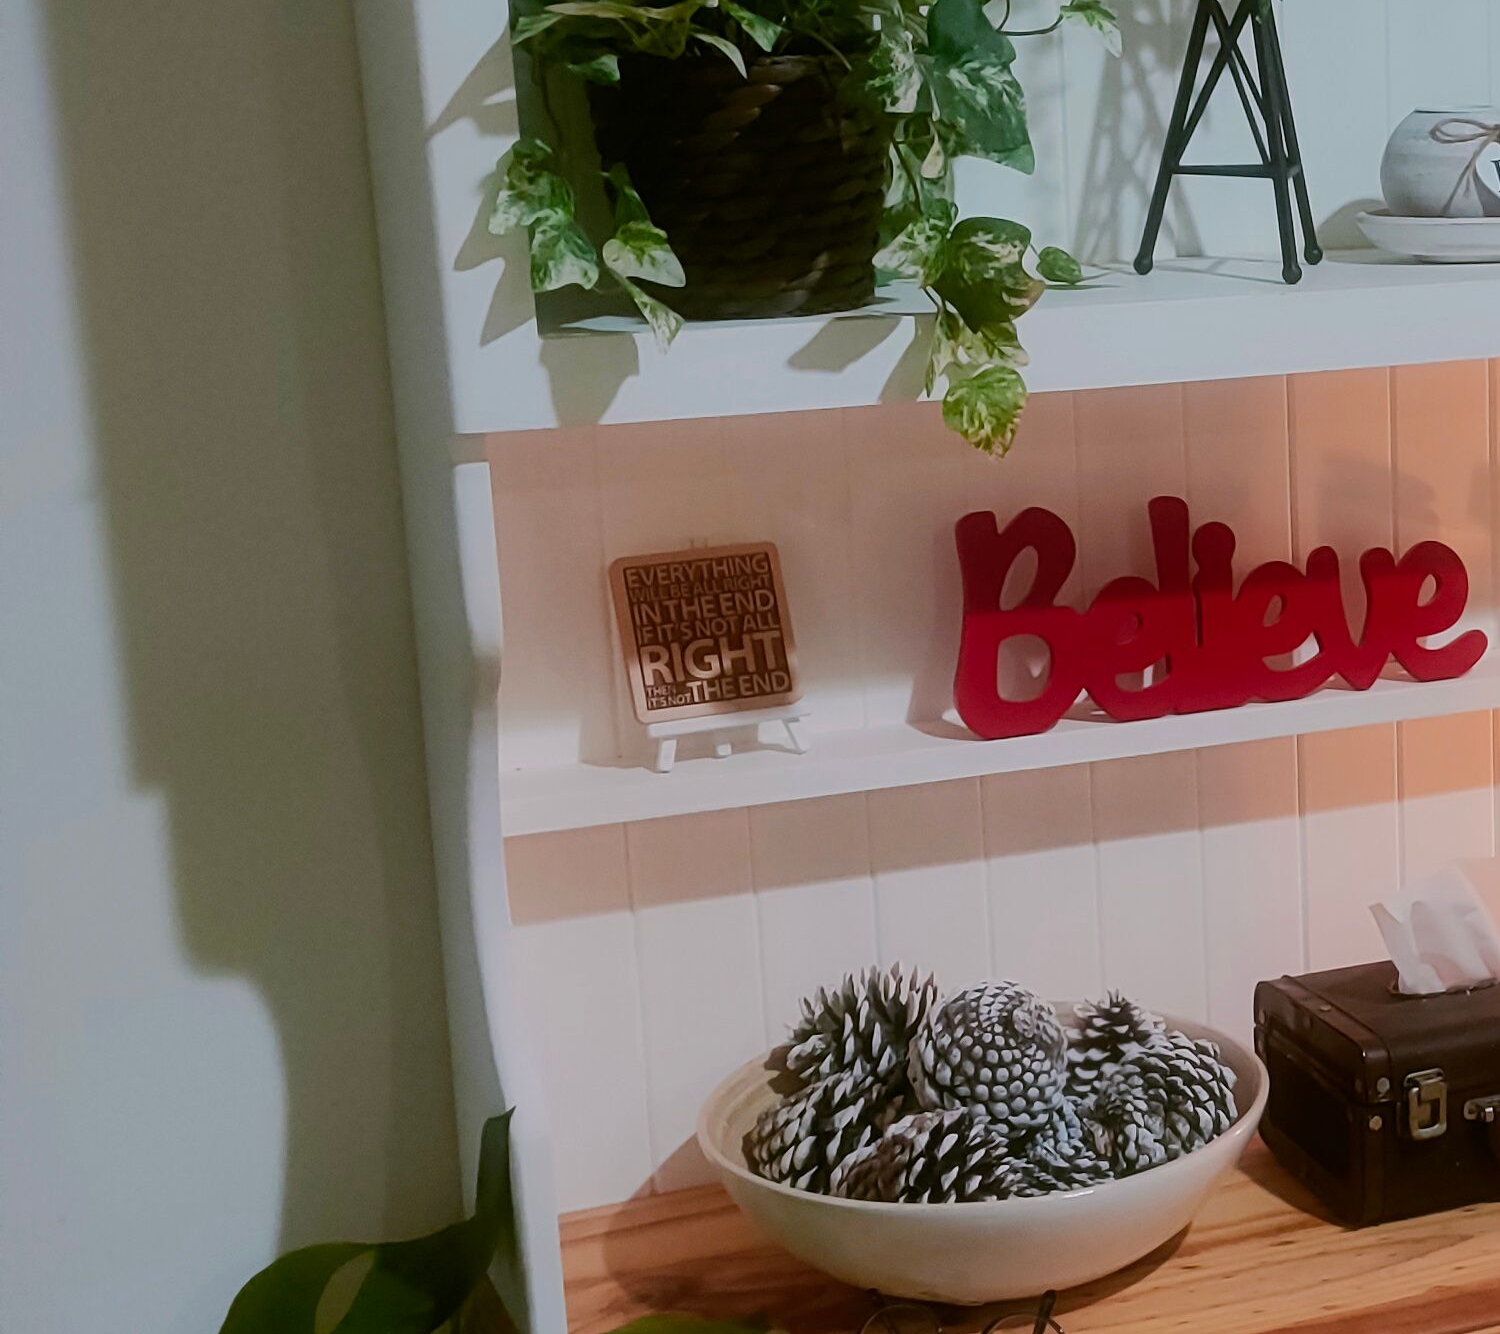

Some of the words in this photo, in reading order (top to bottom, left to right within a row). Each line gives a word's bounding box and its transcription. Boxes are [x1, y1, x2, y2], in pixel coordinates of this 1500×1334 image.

[626, 554, 769, 588] EVERYTHING
[629, 585, 669, 603] WILL
[670, 583, 691, 599] BE
[693, 578, 721, 595] ALL
[722, 573, 771, 592] RIGHT
[632, 602, 662, 626] IN
[662, 595, 717, 622] THE
[719, 589, 775, 615] END
[953, 495, 1488, 740] Believe
[636, 626, 654, 645] IF
[656, 622, 694, 643] IT'S
[694, 617, 738, 638] NOT
[743, 612, 780, 632] ALL
[640, 630, 781, 686] RIGHT
[645, 684, 677, 697] THEN
[667, 692, 691, 706] NOT
[686, 677, 737, 703] THE
[739, 670, 790, 696] END
